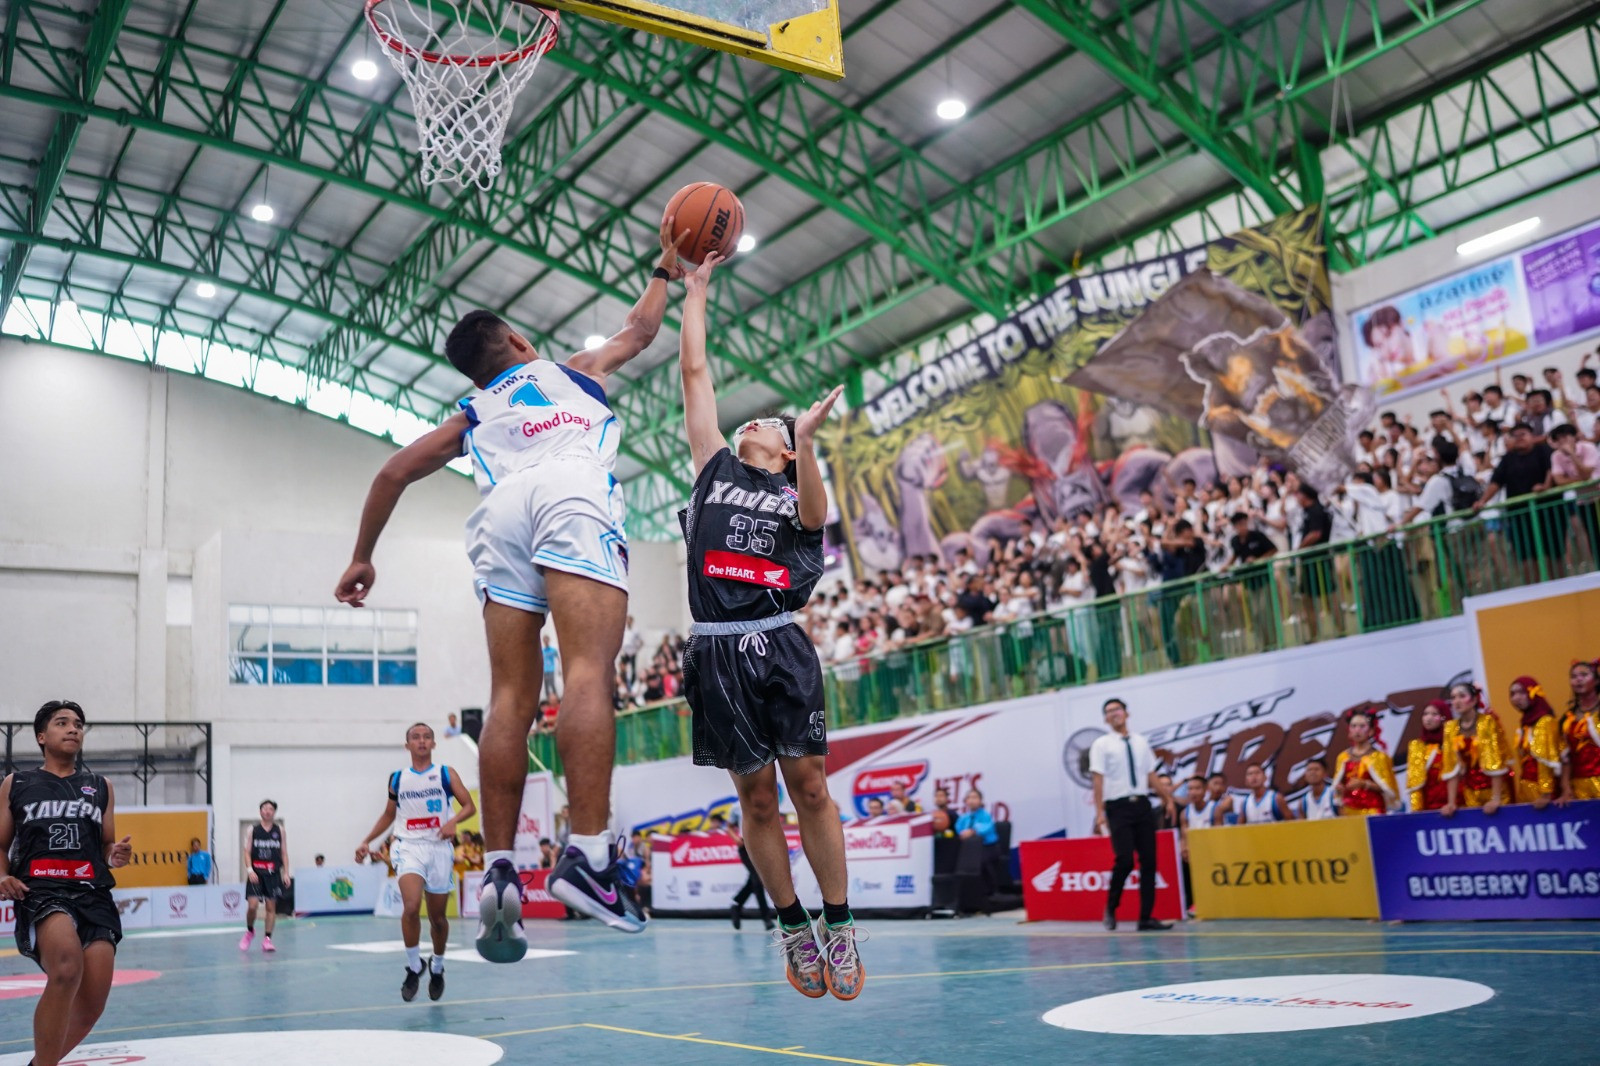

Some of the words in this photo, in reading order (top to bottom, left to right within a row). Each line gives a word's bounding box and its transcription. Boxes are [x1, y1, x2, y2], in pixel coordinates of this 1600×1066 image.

[711, 208, 731, 241] DBL
[864, 342, 989, 436] WELCOME
[980, 322, 1028, 371] TO
[1019, 285, 1078, 346] THE
[508, 381, 558, 408] 1
[704, 480, 803, 531] XAVEP
[726, 513, 780, 556] 35
[708, 564, 725, 575] One
[725, 566, 756, 580] HEART.
[48, 823, 81, 850] 21
[1416, 825, 1506, 856] ULTRA
[1509, 821, 1588, 853] MILK
[1211, 857, 1350, 887] azarine
[1408, 873, 1528, 897] BLUEBERRY
[1536, 871, 1600, 896] BLAS
[1279, 997, 1414, 1009] Honda
